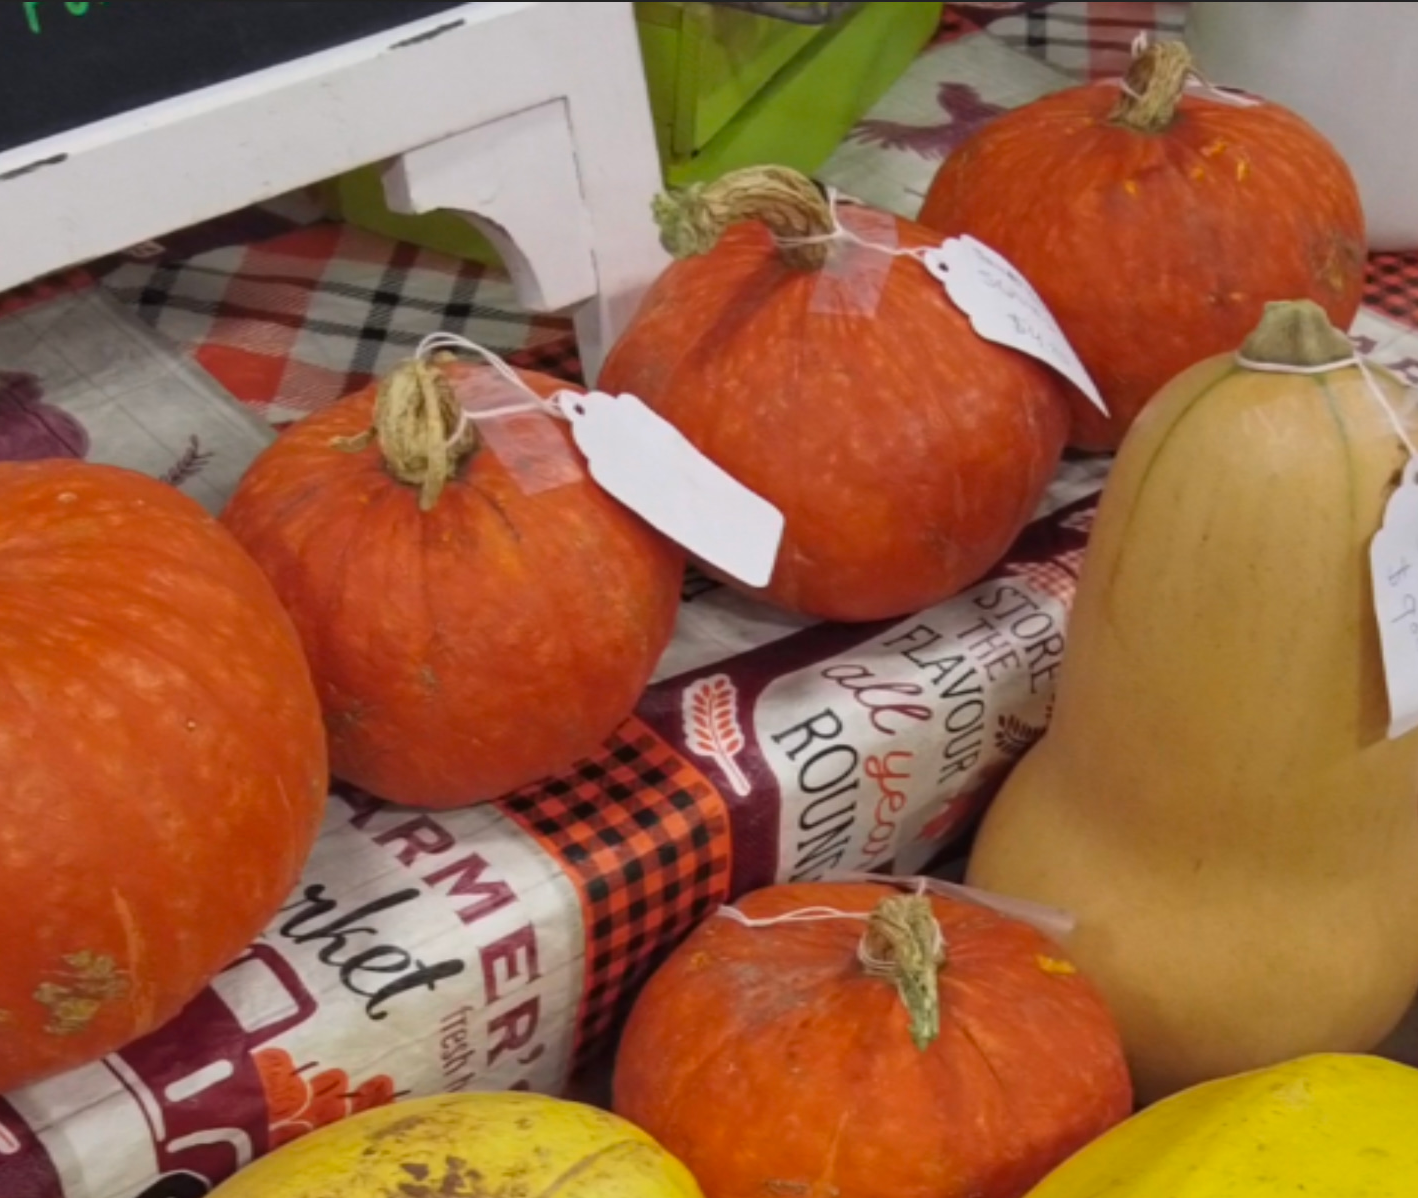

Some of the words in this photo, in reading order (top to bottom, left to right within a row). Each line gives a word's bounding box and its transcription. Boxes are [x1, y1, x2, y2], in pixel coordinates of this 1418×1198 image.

[955, 616, 1023, 683] THE
[972, 585, 1065, 695] STORE
[820, 663, 934, 736] all
[883, 623, 985, 784] FLAVOUR
